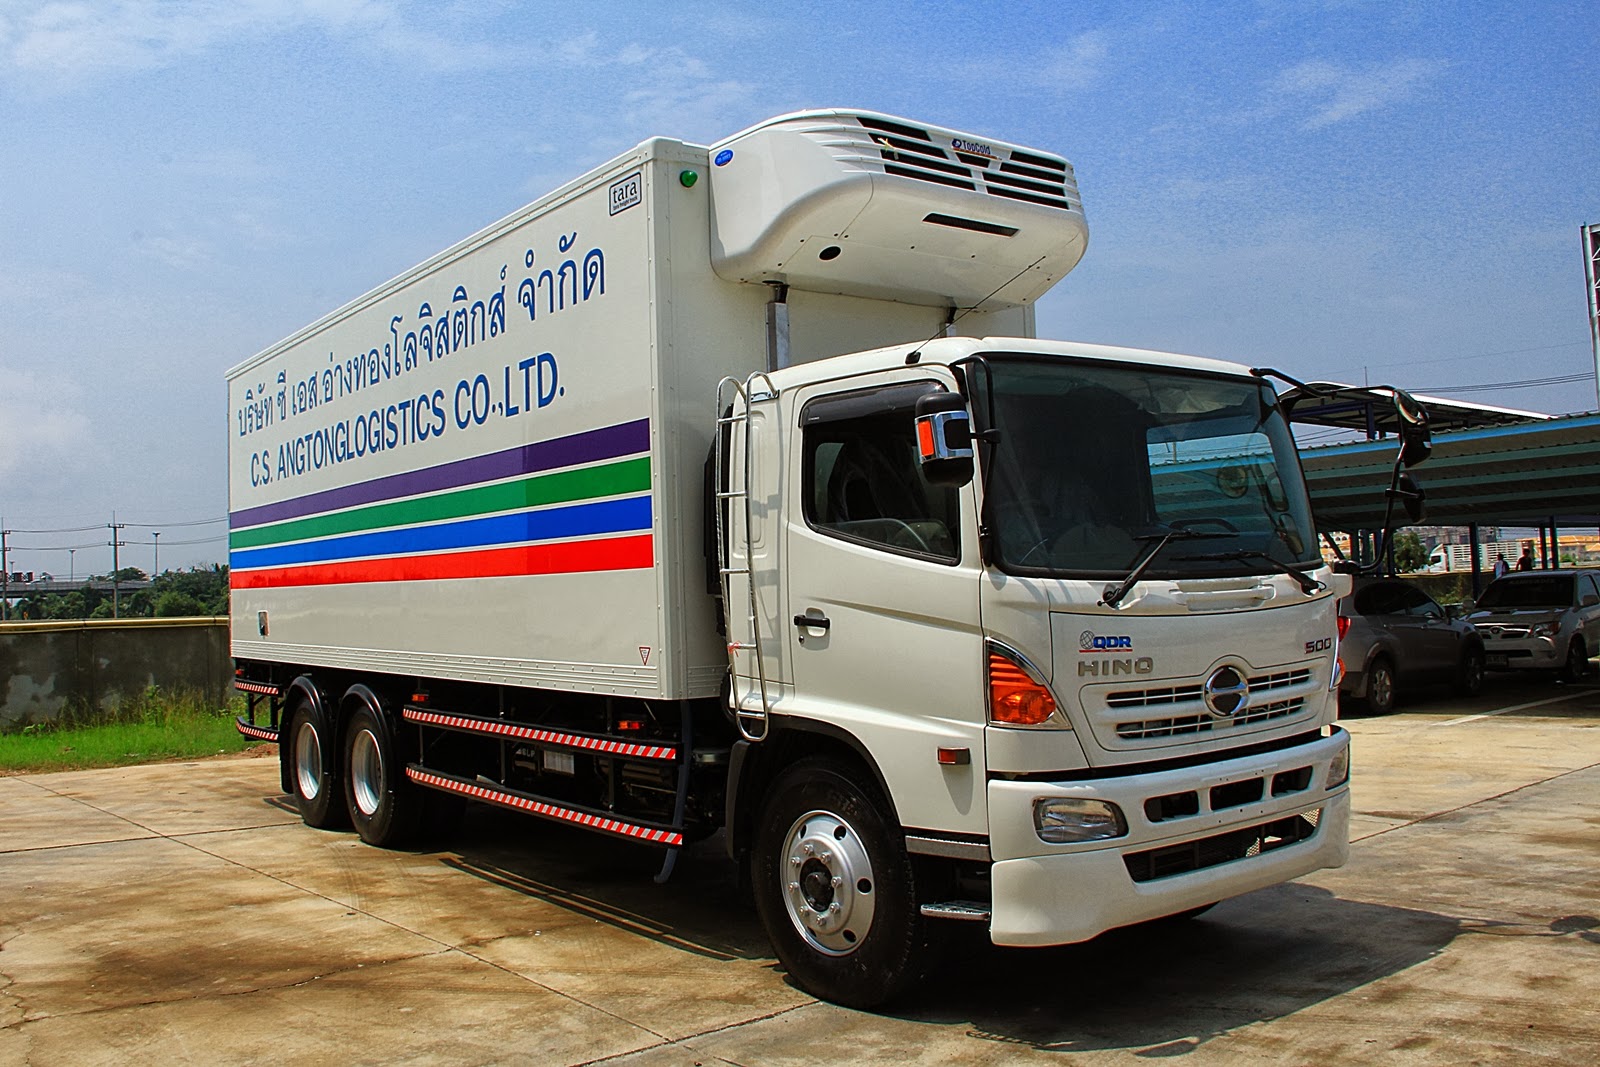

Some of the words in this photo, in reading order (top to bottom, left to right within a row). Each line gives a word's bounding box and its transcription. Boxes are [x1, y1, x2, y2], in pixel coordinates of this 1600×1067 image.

[613, 182, 637, 203] tara
[238, 382, 273, 437] บริษัท
[277, 369, 287, 421] ซี
[517, 232, 605, 321] จำกัด
[251, 449, 273, 488] C.S.
[277, 389, 447, 481] ANGTONGLOGISTICS
[454, 352, 566, 430] CO.,LTD.
[1093, 636, 1132, 649] QDR
[1304, 637, 1332, 655] 500
[1078, 656, 1154, 677] HINO
